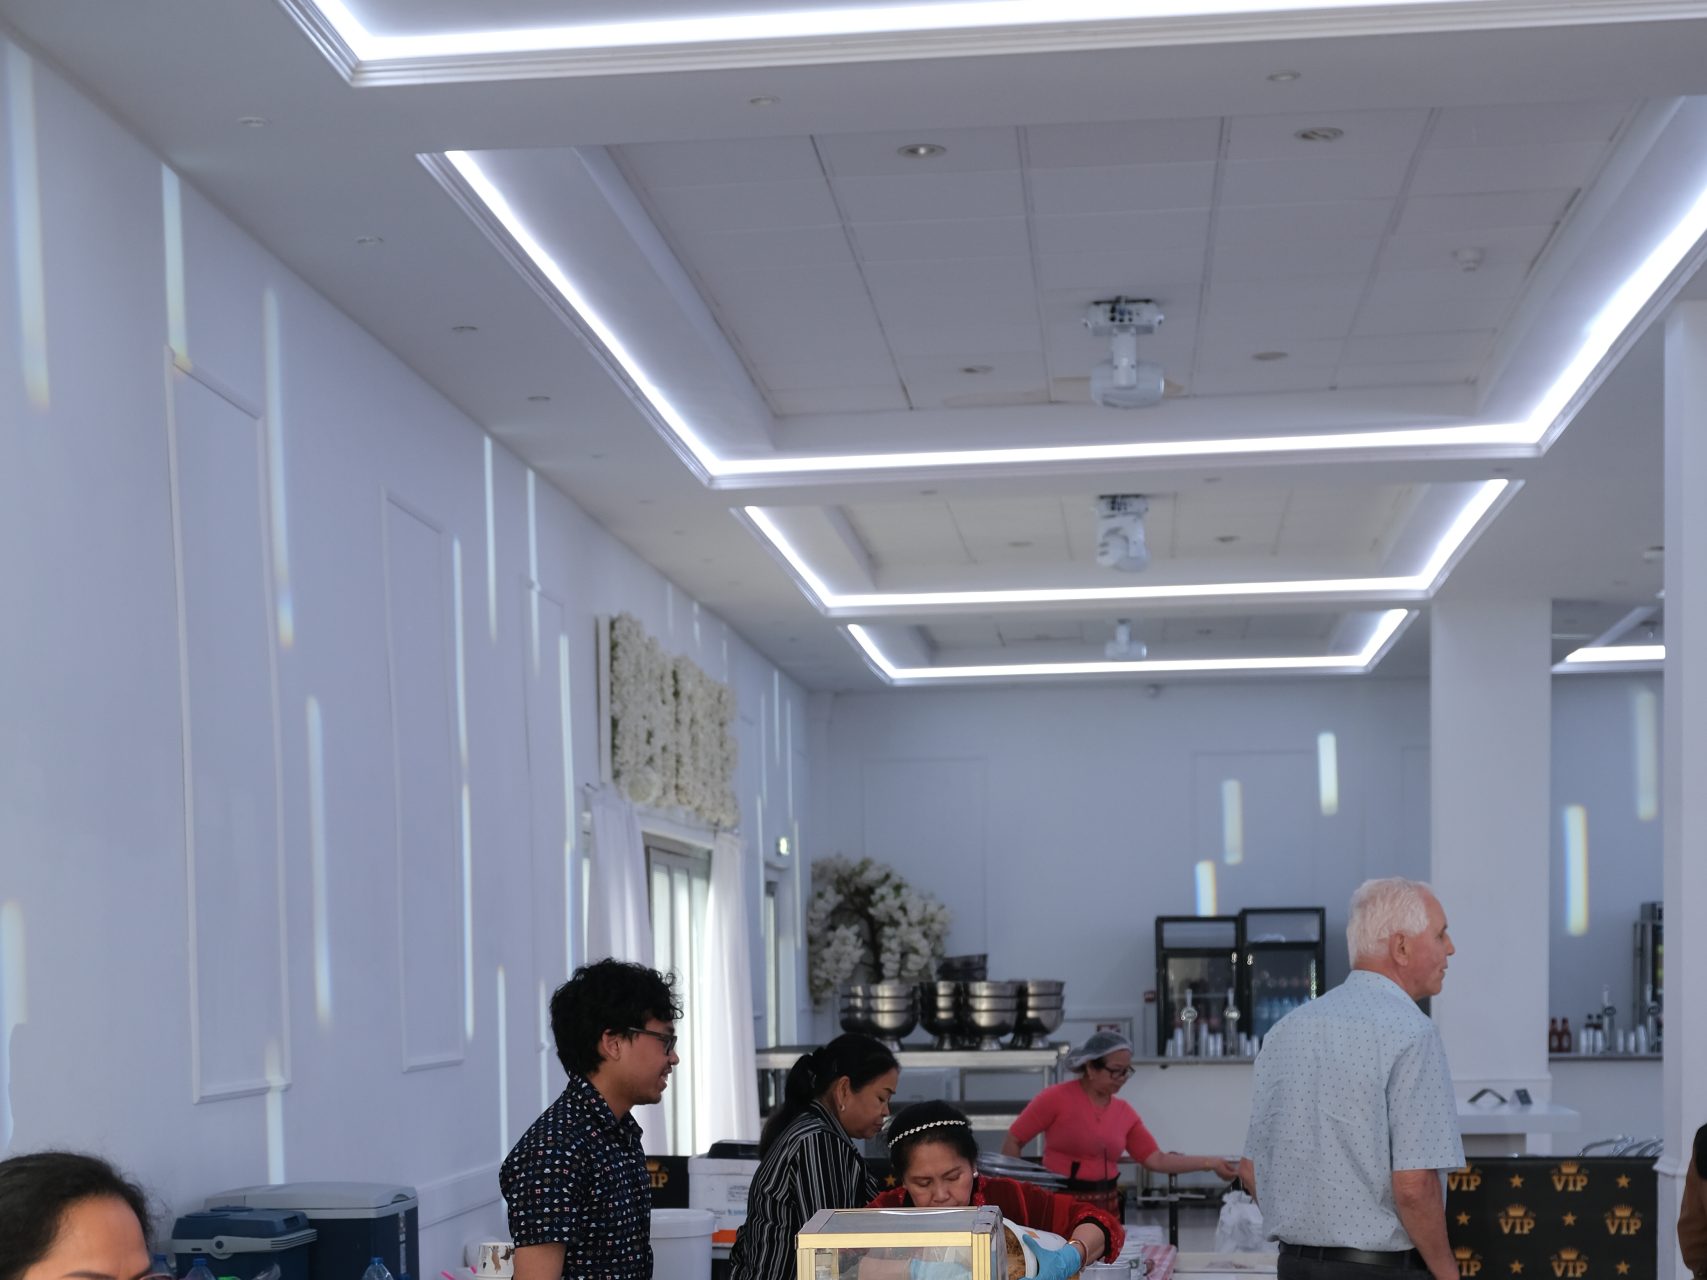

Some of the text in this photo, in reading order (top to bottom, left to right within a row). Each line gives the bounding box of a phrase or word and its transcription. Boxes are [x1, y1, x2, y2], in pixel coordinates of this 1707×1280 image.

[649, 1172, 669, 1188] IP
[1448, 1175, 1481, 1191] VIP
[1552, 1175, 1588, 1192] VIP
[1500, 1218, 1535, 1234] VIP
[1606, 1219, 1642, 1235] VIP
[1458, 1261, 1482, 1277] IP
[1552, 1261, 1588, 1278] VIP
